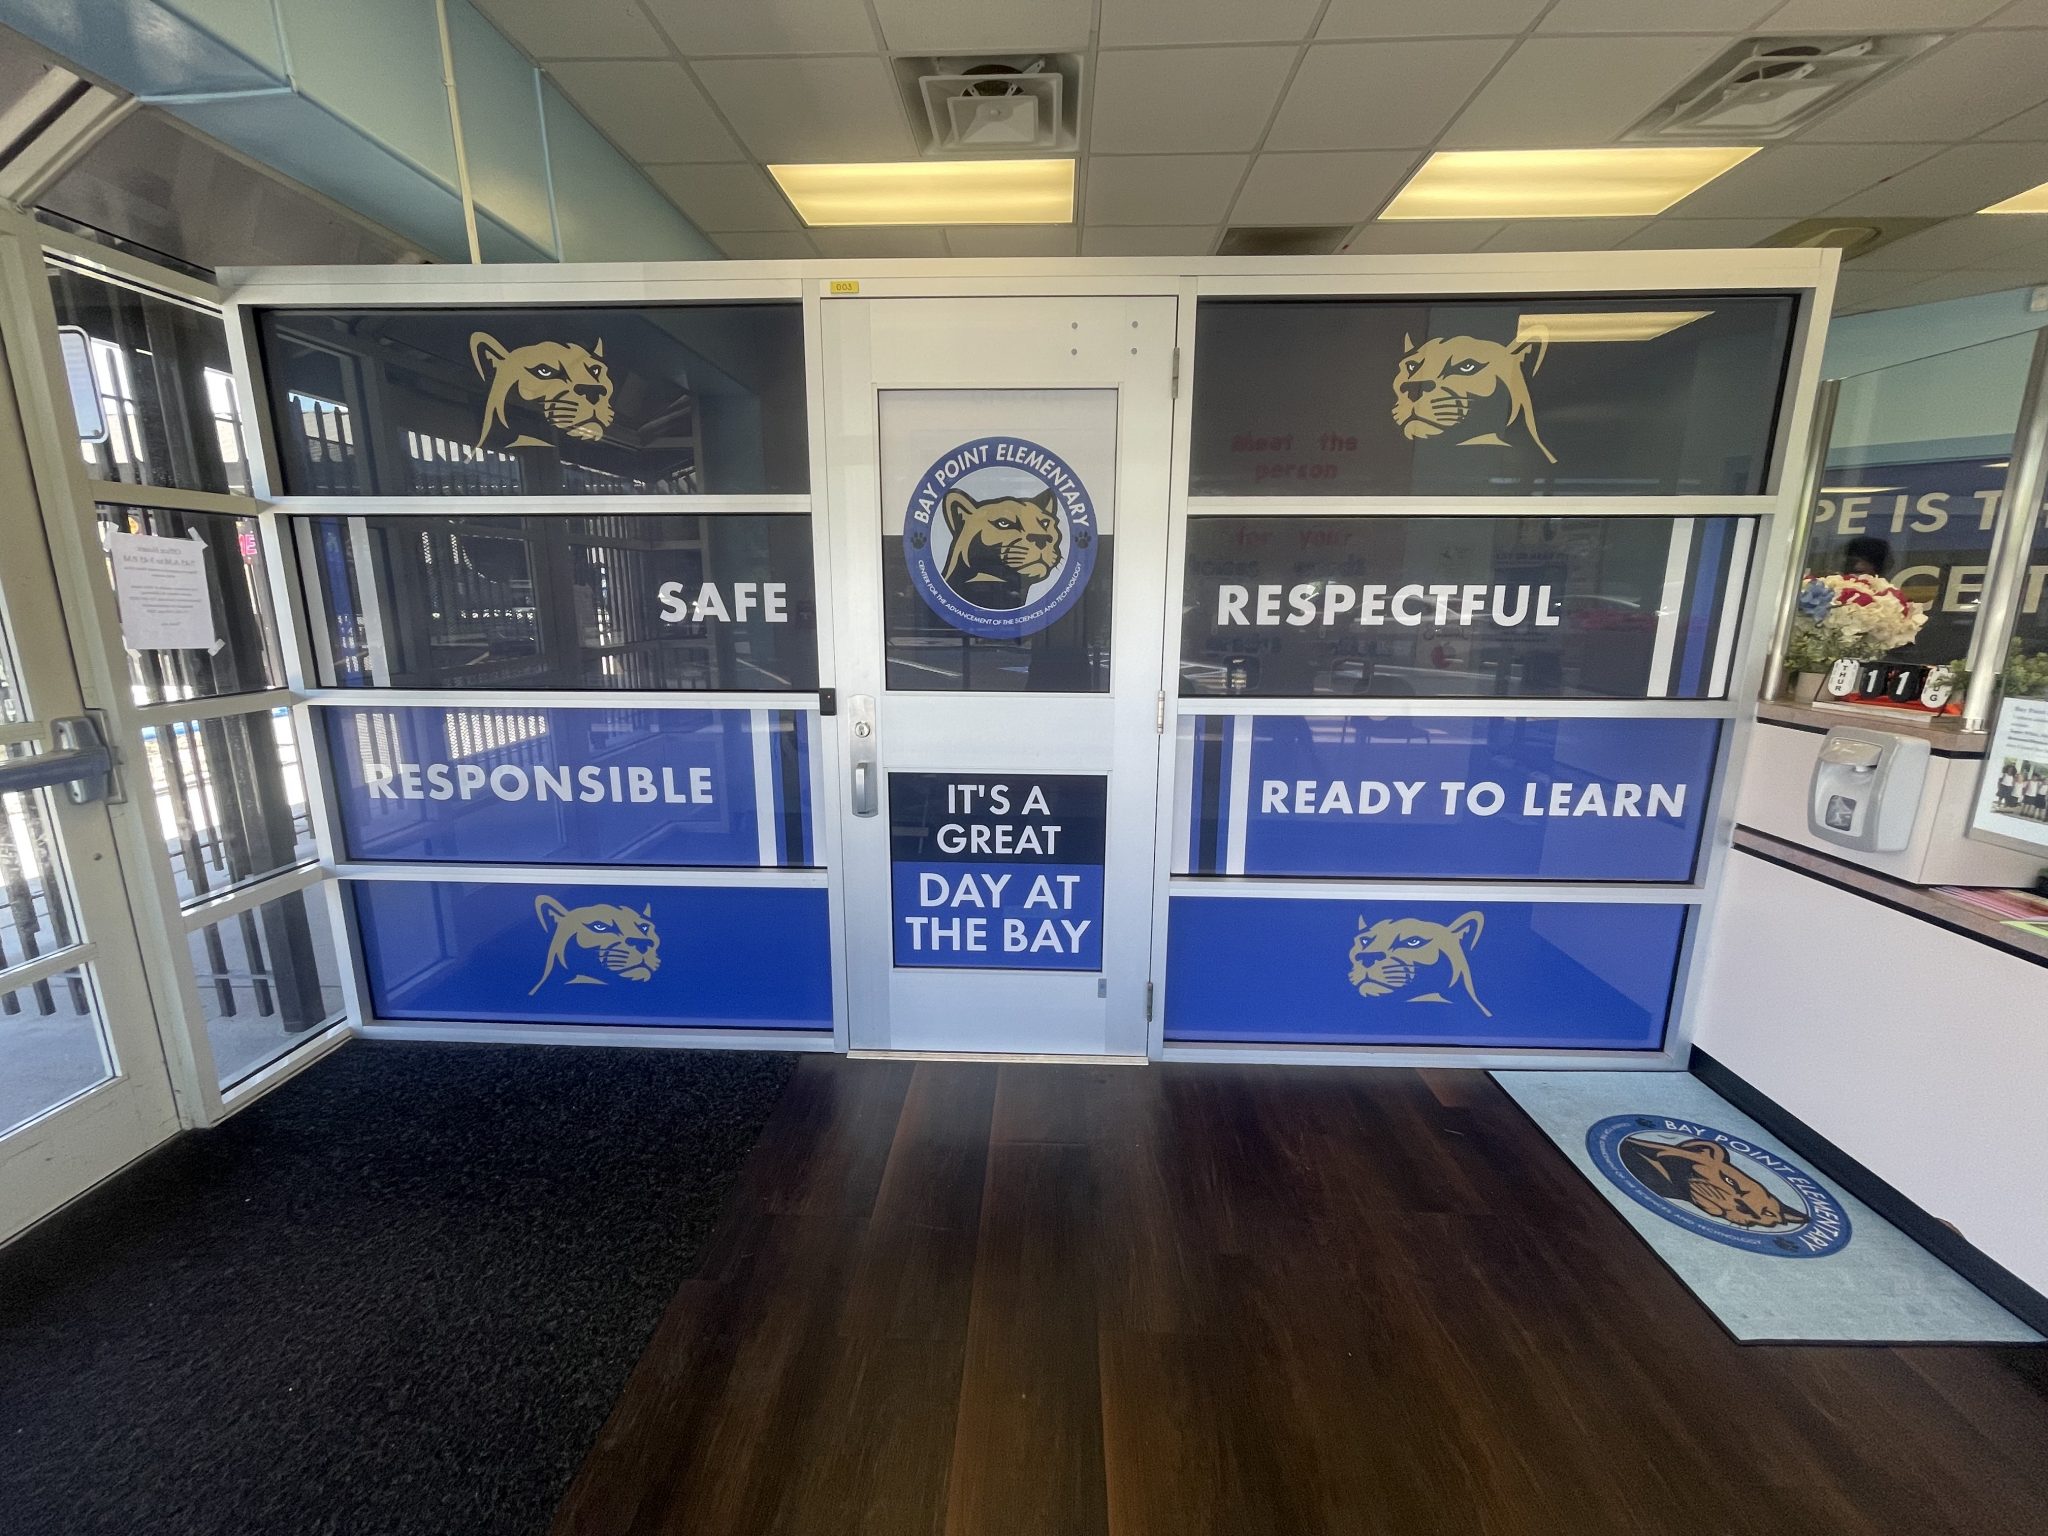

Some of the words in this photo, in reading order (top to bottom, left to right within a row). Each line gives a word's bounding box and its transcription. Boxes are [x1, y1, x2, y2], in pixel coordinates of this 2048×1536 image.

[914, 482, 938, 524] BAY
[934, 445, 989, 488] POINT
[996, 443, 1090, 527] ELEMENTARY
[1891, 492, 1950, 533] IS
[658, 581, 788, 623] SAFE
[918, 559, 930, 583] CENTER
[928, 583, 938, 597] FOR
[936, 594, 947, 606] THE
[945, 604, 992, 625] ADVANCEMENT
[992, 618, 1002, 626] OF
[1015, 609, 1044, 624] SCIENCES
[1044, 601, 1058, 613] AND
[1055, 561, 1082, 603] TECHNOLOGY
[1217, 584, 1561, 627] RESPECTFUL
[366, 763, 714, 804] RESPONSIBLE
[948, 784, 1011, 815] IT'S
[1021, 785, 1051, 815] A
[1261, 780, 1427, 815] READY
[1440, 781, 1506, 817] TO
[1523, 782, 1687, 818] LEARN
[936, 823, 1062, 854] GREAT
[919, 872, 1012, 908] DAY
[1023, 874, 1081, 909] AT
[905, 916, 987, 951] THE
[1003, 918, 1092, 954] BAY
[1665, 1120, 1705, 1136] BAY
[1714, 1134, 1796, 1174] POINT
[1787, 1176, 1840, 1252] ELEMENTARY
